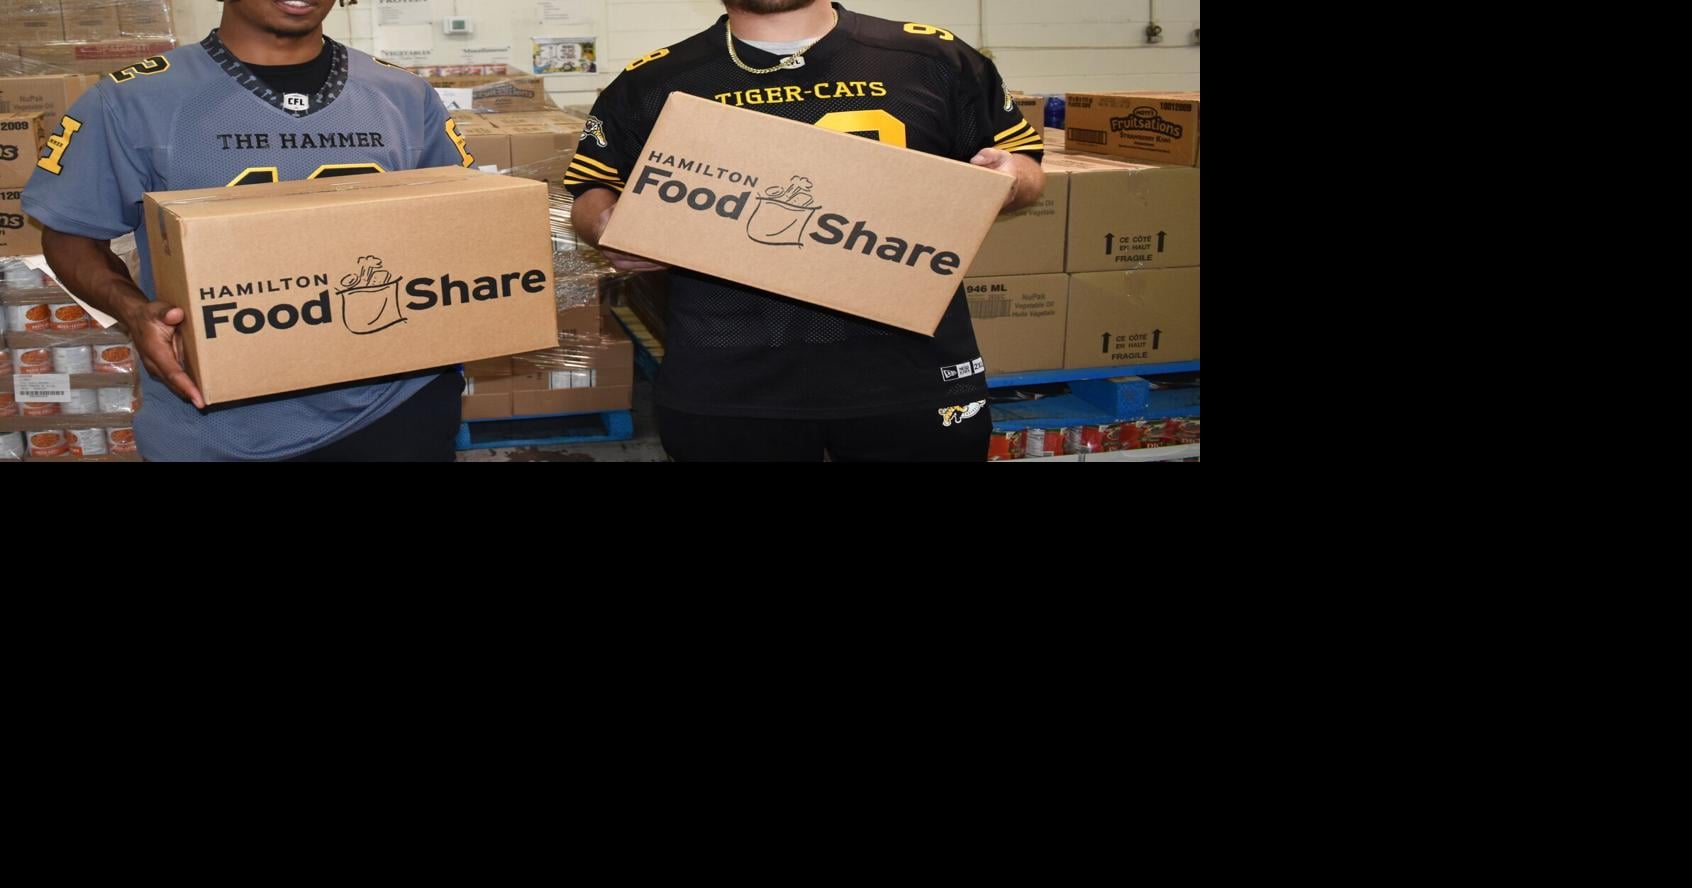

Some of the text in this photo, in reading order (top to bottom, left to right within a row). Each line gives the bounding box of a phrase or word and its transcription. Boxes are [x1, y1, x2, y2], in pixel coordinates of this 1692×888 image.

[287, 97, 305, 106] CFL
[715, 81, 887, 107] TIGER-CATS
[1110, 117, 1183, 138] Fruitsations
[217, 132, 385, 150] THE HAMMER
[648, 150, 759, 188] HAMILTON
[632, 165, 961, 276] Food Share
[1114, 254, 1153, 262] FRAGILE
[199, 274, 329, 300] HAMILTON
[966, 283, 1008, 294] 946 ML
[202, 269, 546, 339] Food Share
[1111, 351, 1148, 360] FRAGILE
